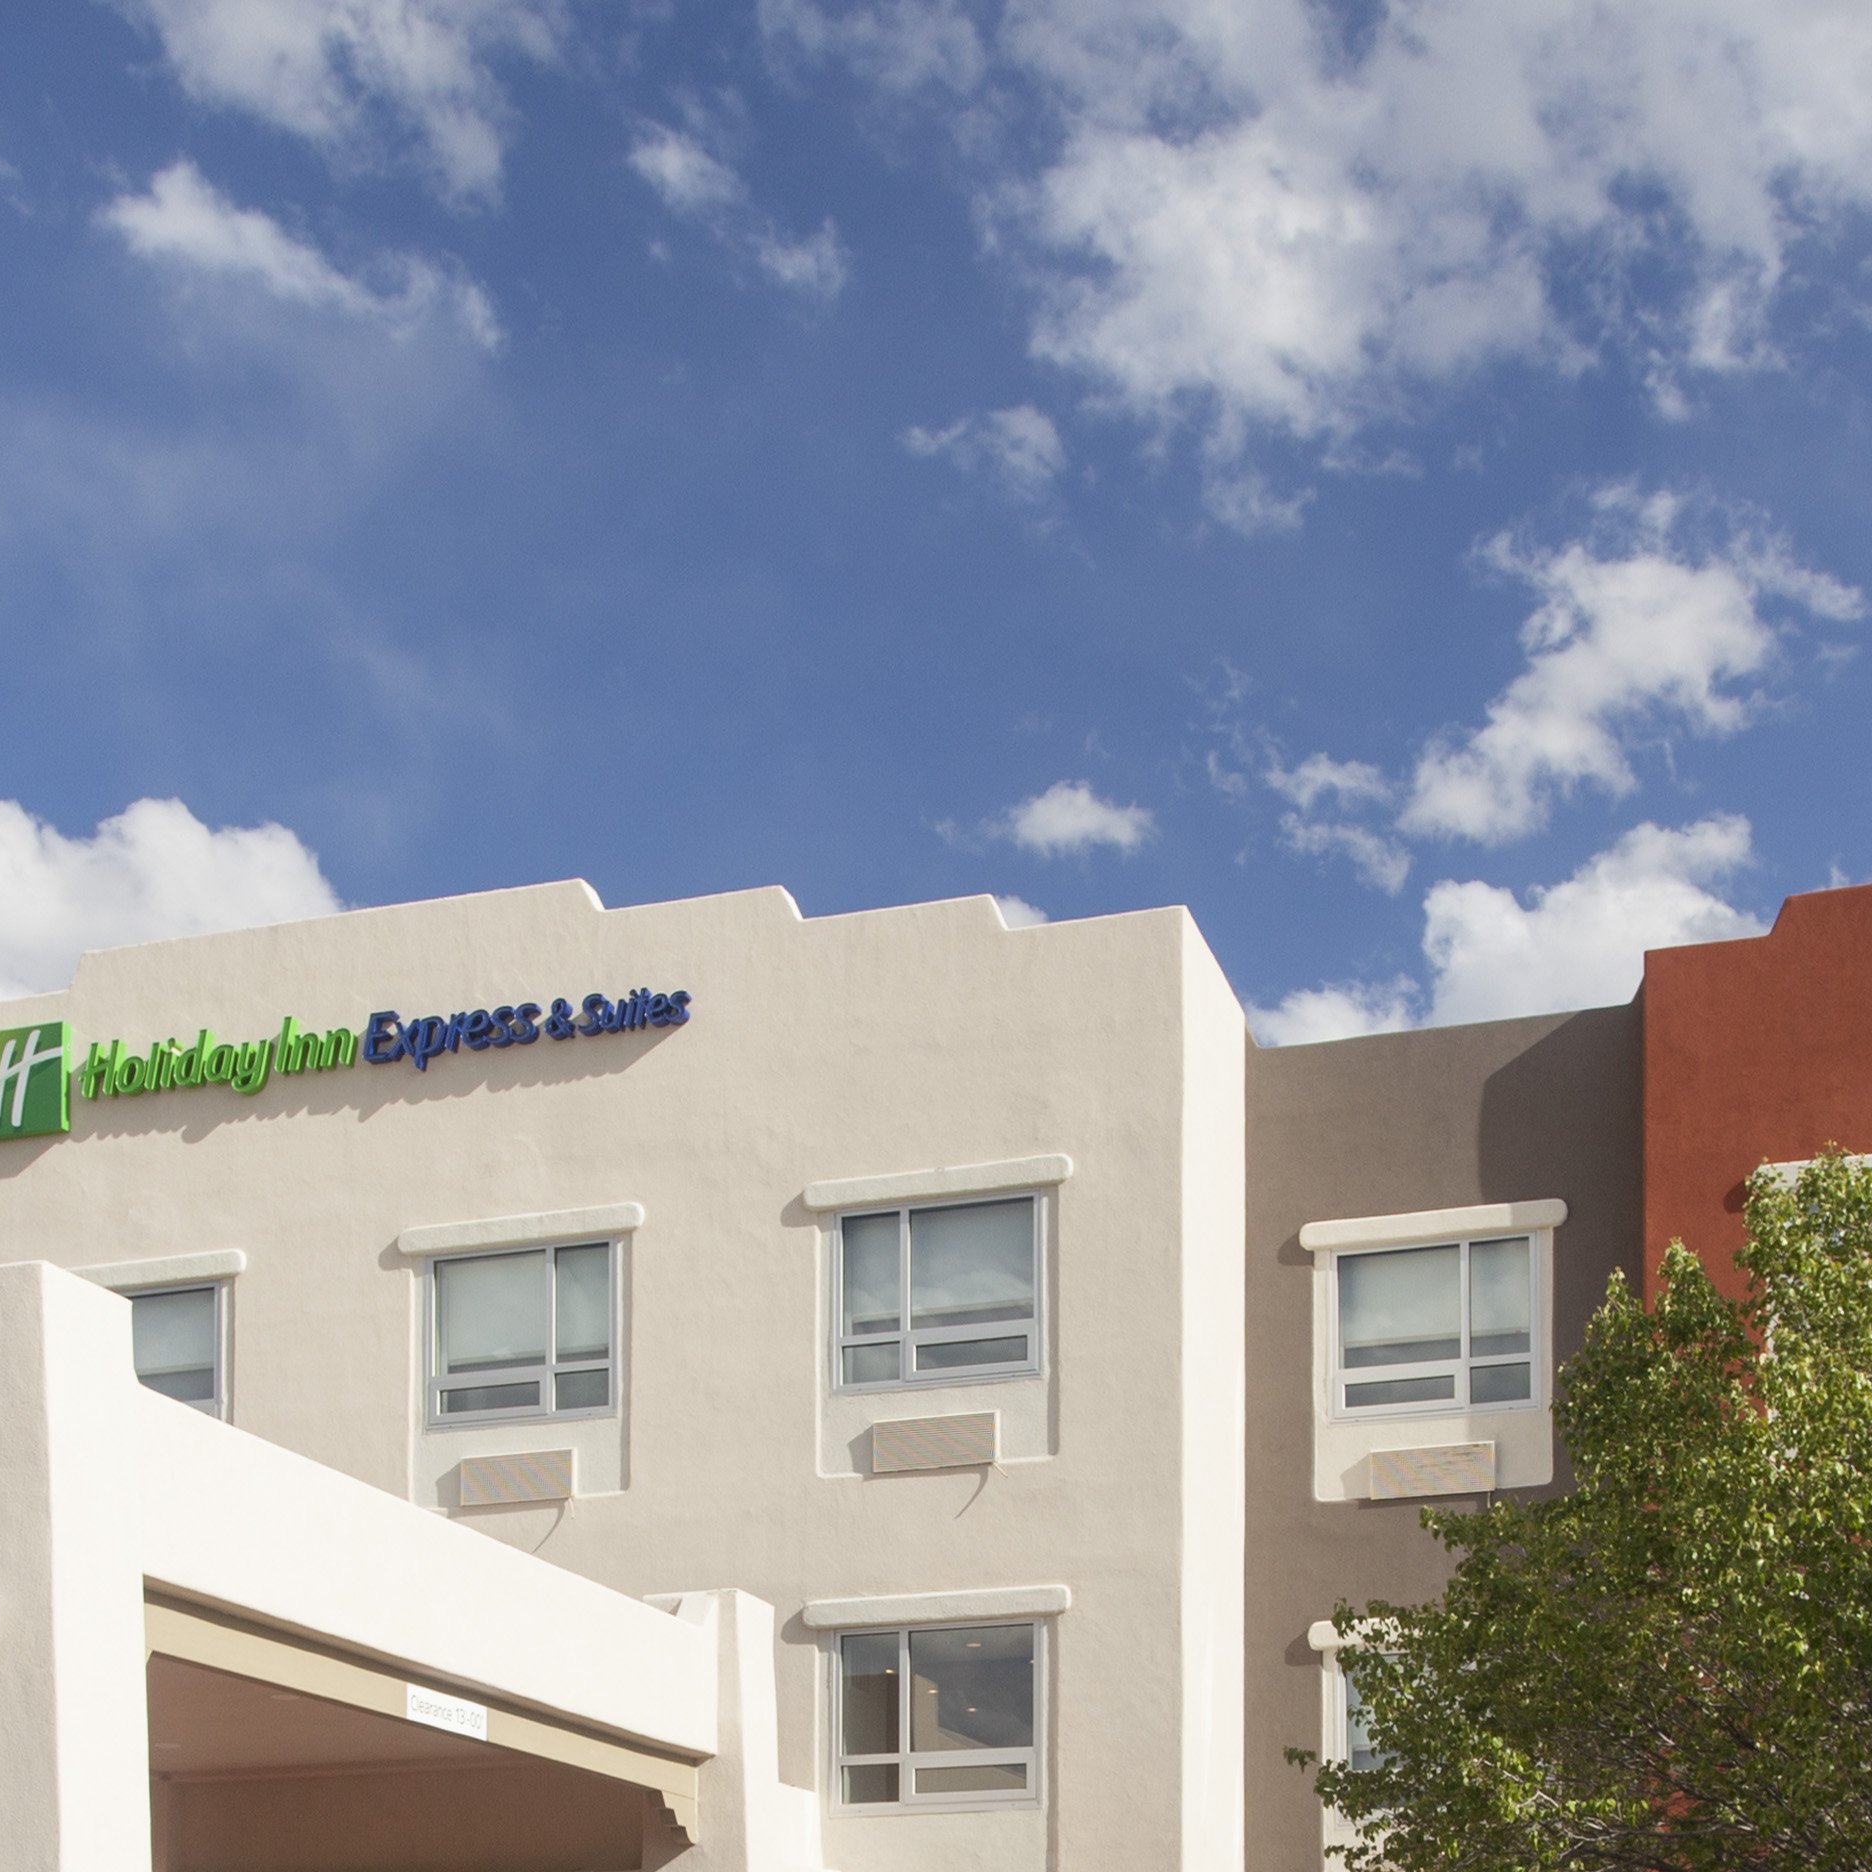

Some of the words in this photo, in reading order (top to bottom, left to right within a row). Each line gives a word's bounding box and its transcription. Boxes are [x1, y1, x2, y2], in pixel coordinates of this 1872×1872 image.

[78, 1028, 273, 1099] Holiday
[274, 1015, 359, 1075] Inn
[362, 1002, 542, 1071] Express
[544, 998, 576, 1039] &
[578, 987, 692, 1037] Suites
[410, 1694, 453, 1723] Clearance
